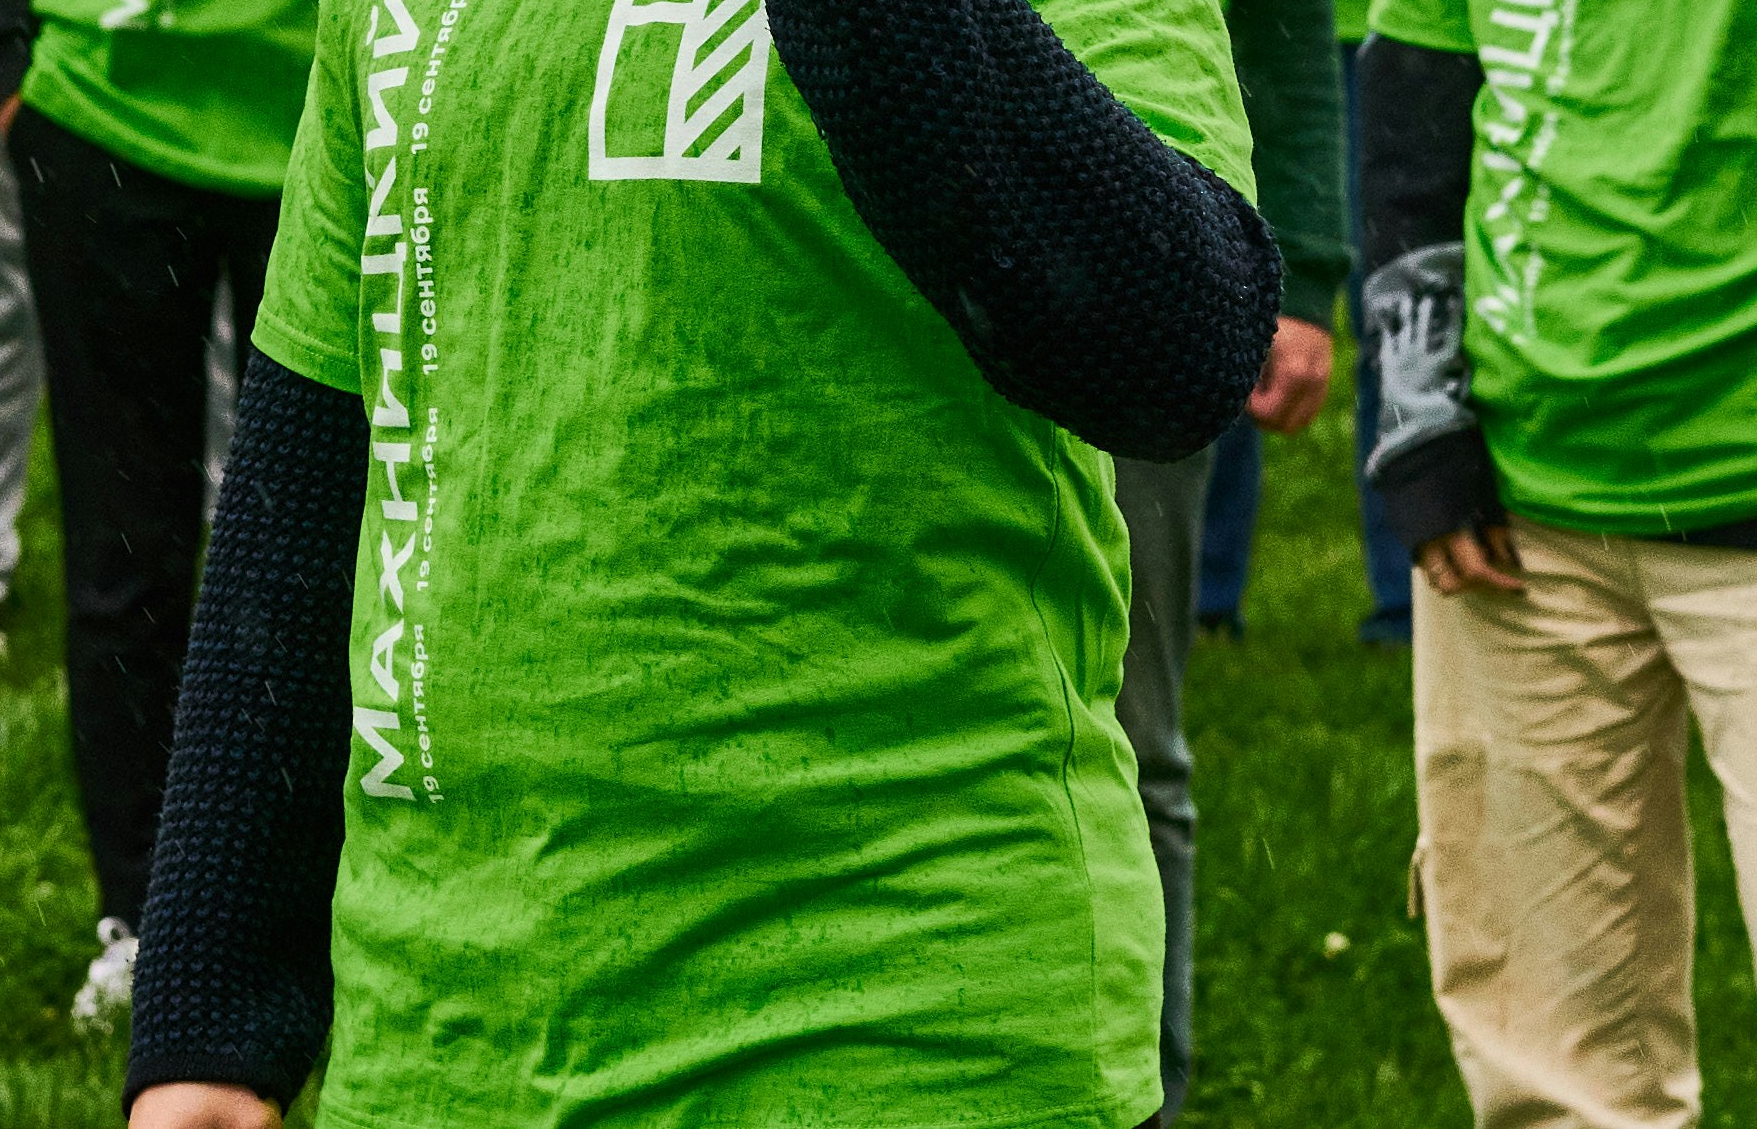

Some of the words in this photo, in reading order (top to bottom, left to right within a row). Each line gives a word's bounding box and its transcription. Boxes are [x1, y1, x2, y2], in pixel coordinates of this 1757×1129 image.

[411, 122, 430, 155] 19
[410, 187, 437, 335] сентября
[422, 343, 439, 375] 19
[421, 407, 438, 553] сентября
[415, 560, 431, 592] 19
[410, 624, 434, 768] сентября
[423, 775, 444, 804] 19
